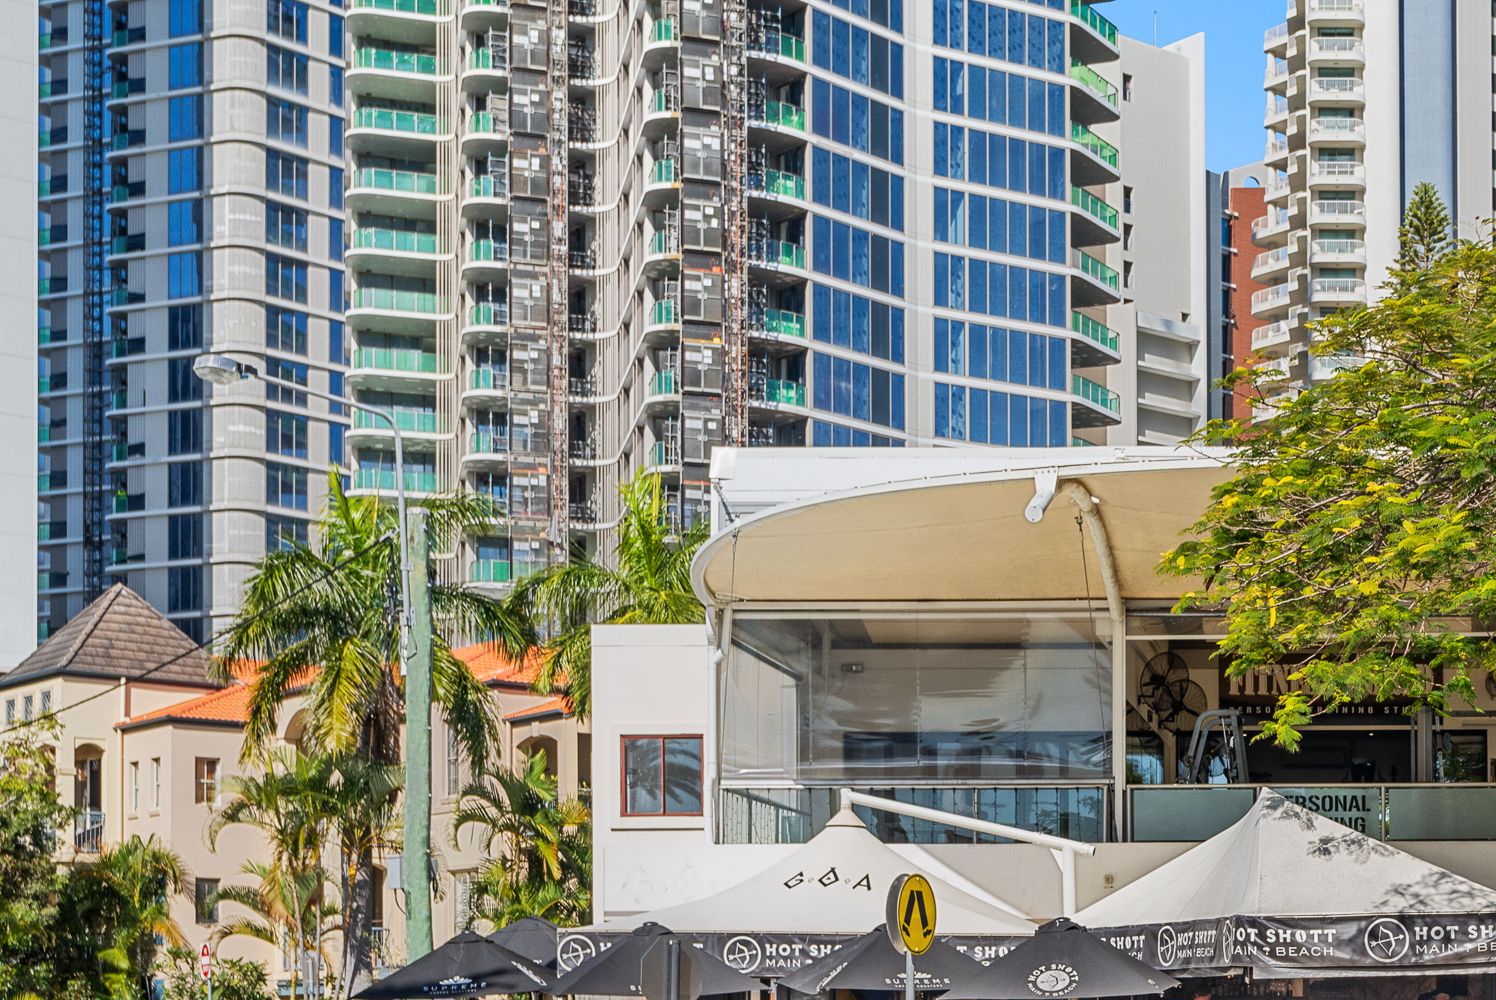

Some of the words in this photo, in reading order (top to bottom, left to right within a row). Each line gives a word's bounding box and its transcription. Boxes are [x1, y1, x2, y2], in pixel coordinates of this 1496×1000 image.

[1266, 928, 1337, 943] SHOTT
[1414, 925, 1459, 941] HOT
[765, 943, 803, 957] HOT
[974, 945, 1016, 959] SHO
[1275, 946, 1334, 957] BEACH
[1415, 943, 1458, 955] MAIN
[765, 958, 801, 968] MAIN
[1028, 965, 1046, 982] HOT
[1051, 963, 1079, 982] SHOTT
[1027, 983, 1043, 996] MAIN
[1053, 982, 1078, 997] BEACH
